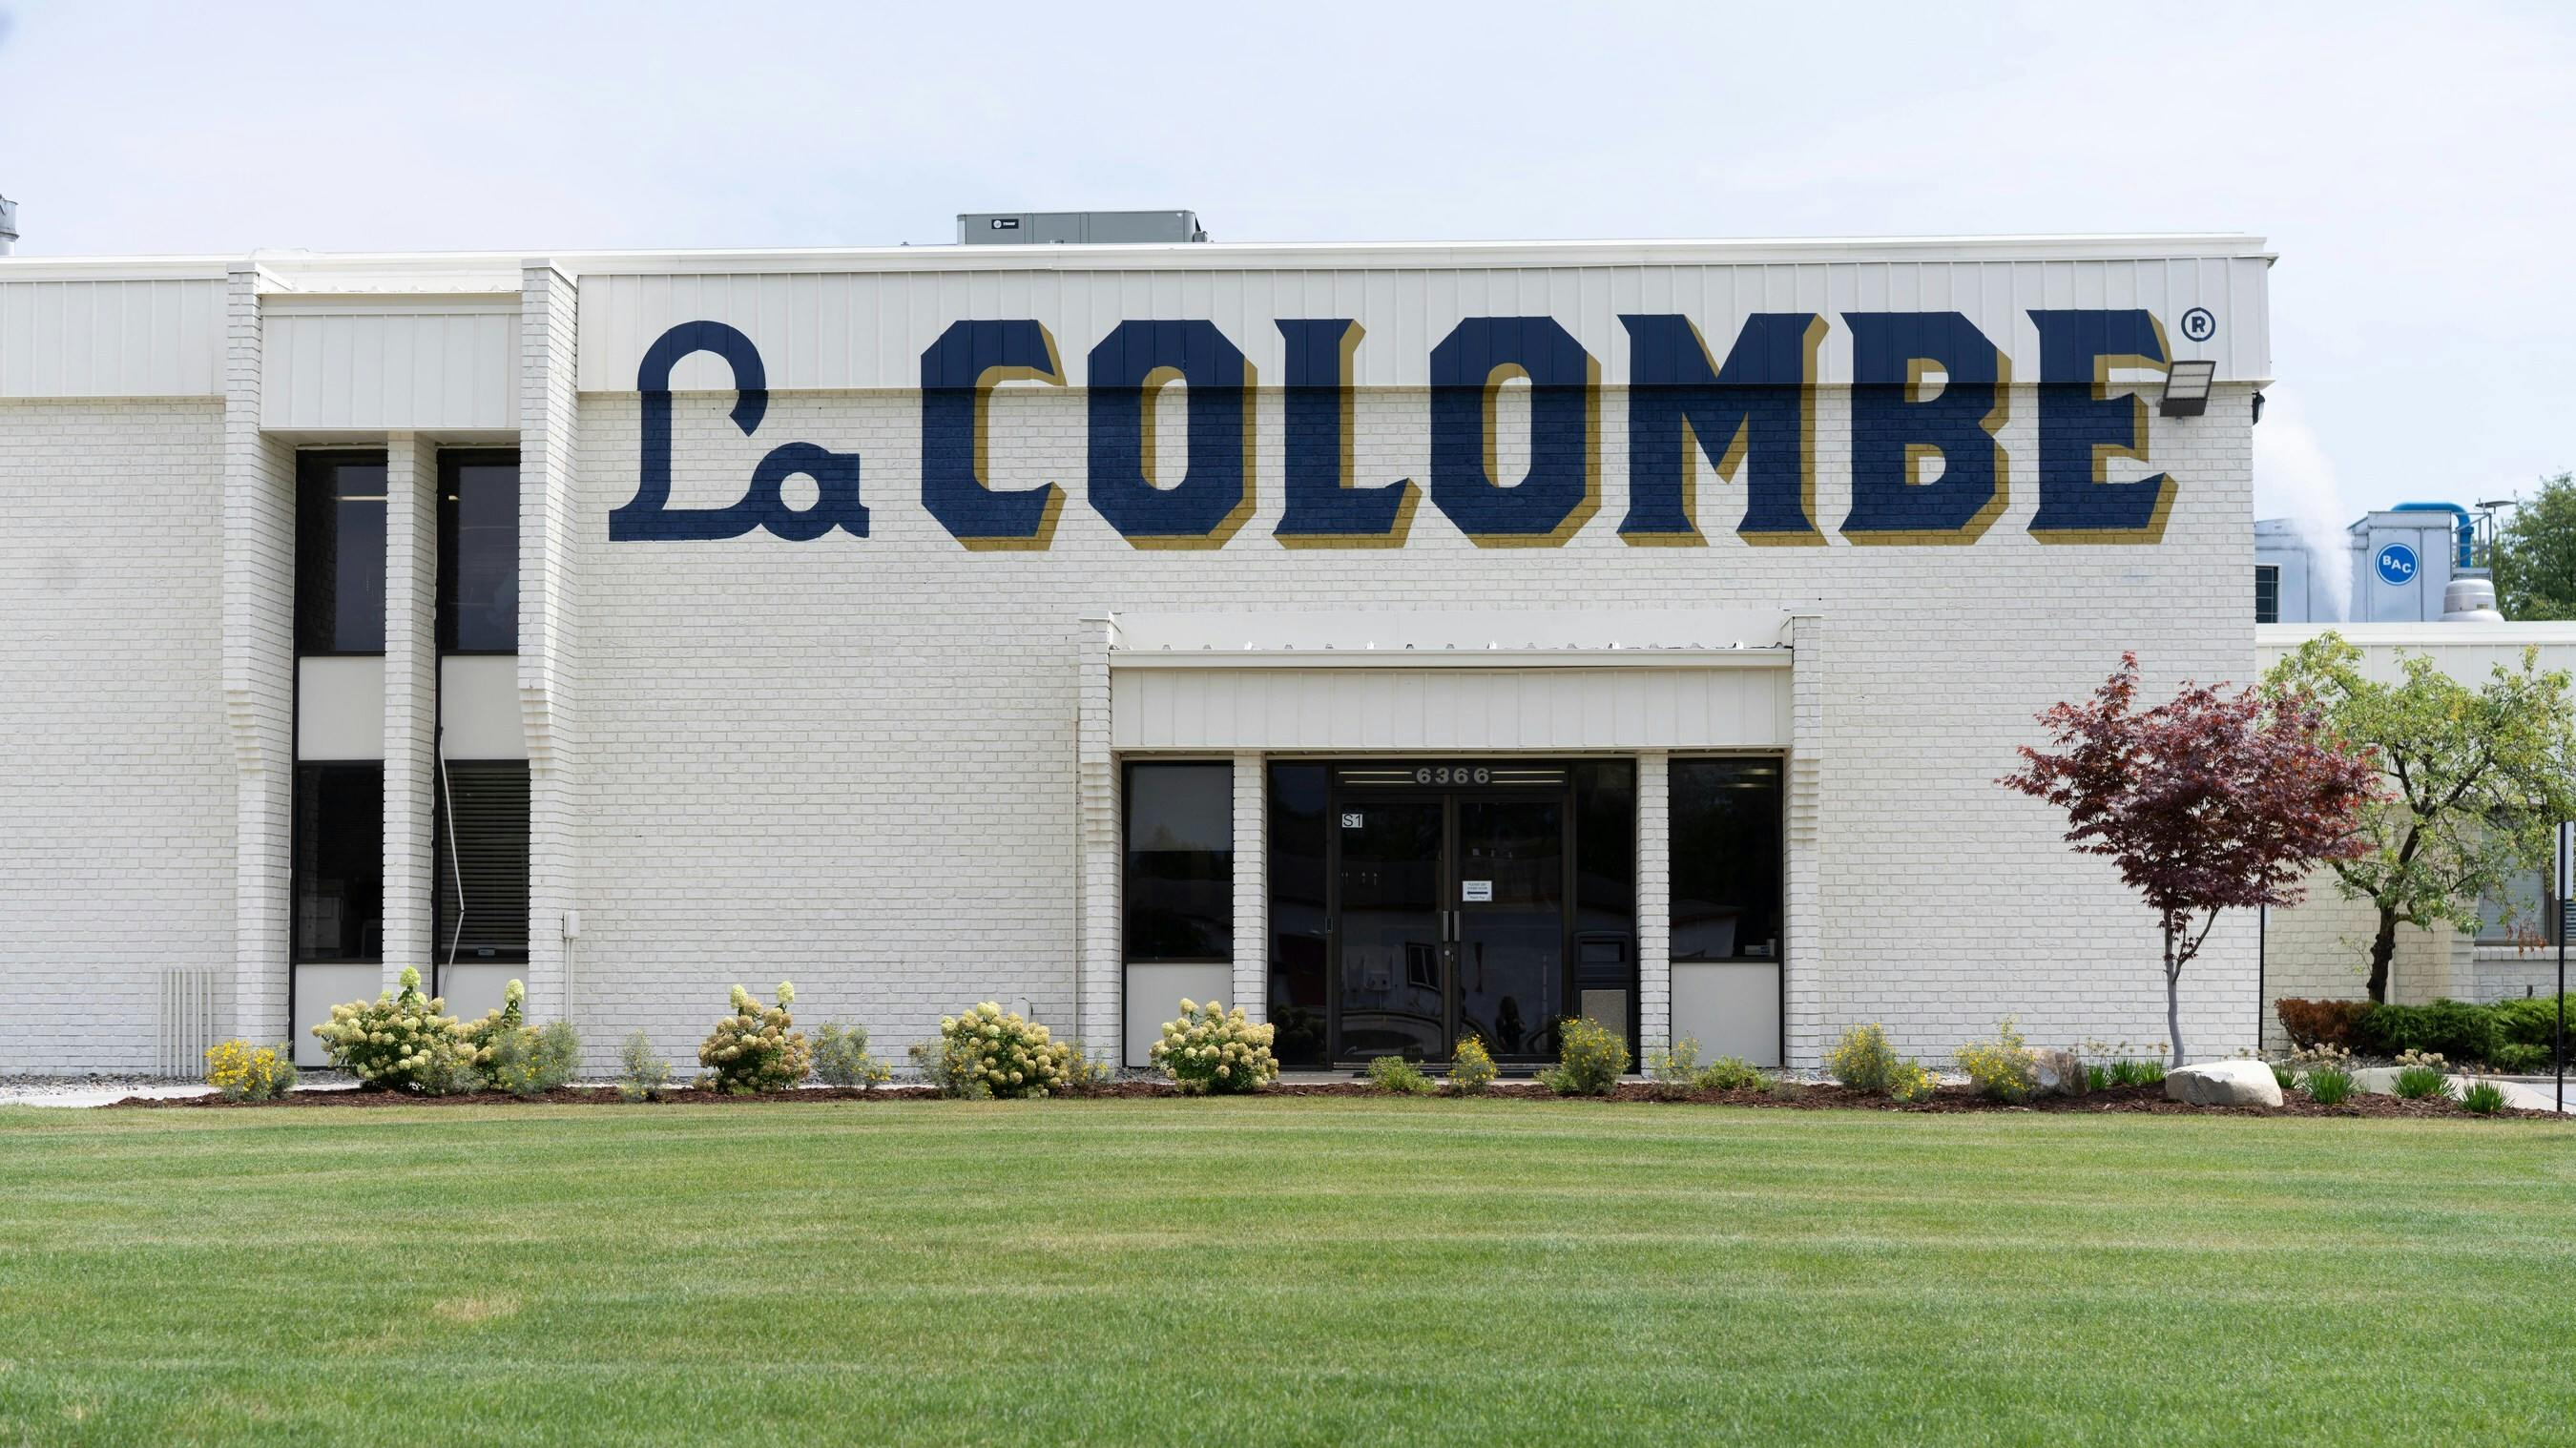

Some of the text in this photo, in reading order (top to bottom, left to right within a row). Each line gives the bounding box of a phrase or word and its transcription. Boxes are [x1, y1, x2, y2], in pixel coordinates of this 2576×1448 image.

[609, 321, 869, 541] La
[921, 310, 2179, 550] COLOMBE
[2382, 555, 2412, 573] BAC
[1416, 767, 1489, 784] 6366
[1342, 814, 1361, 827] S1
